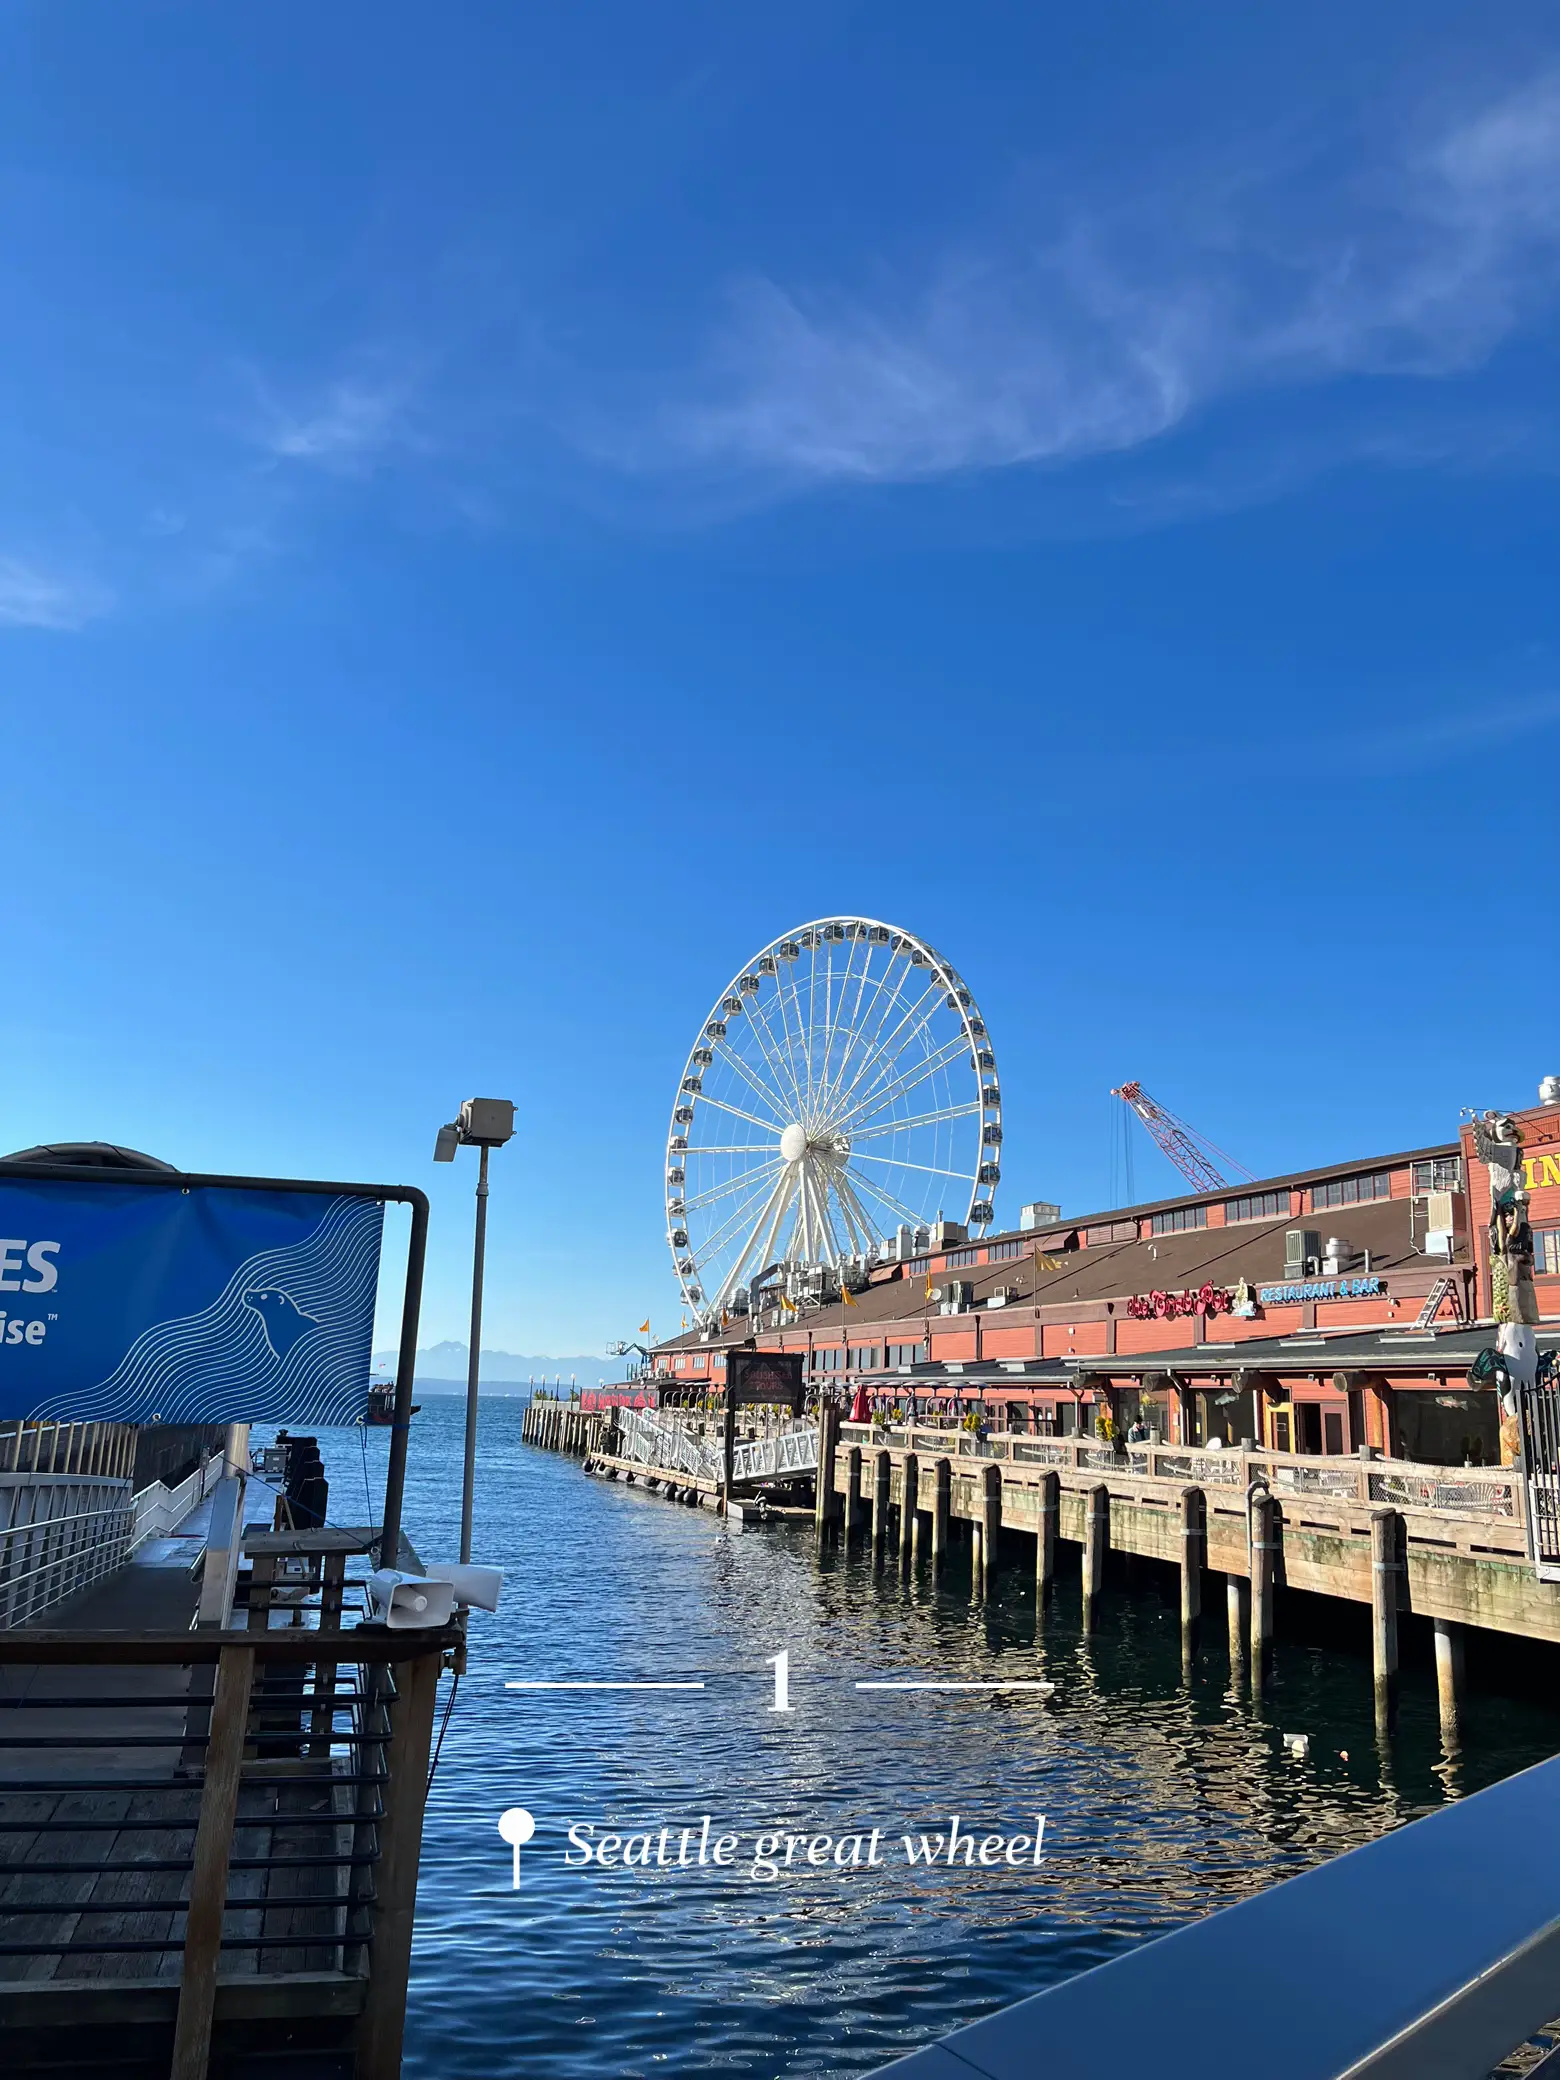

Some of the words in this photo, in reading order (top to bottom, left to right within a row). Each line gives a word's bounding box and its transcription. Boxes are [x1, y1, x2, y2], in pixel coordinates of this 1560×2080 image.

[1260, 1281, 1338, 1302] RESTAURANT
[1340, 1280, 1349, 1296] &
[1352, 1277, 1380, 1295] BAR
